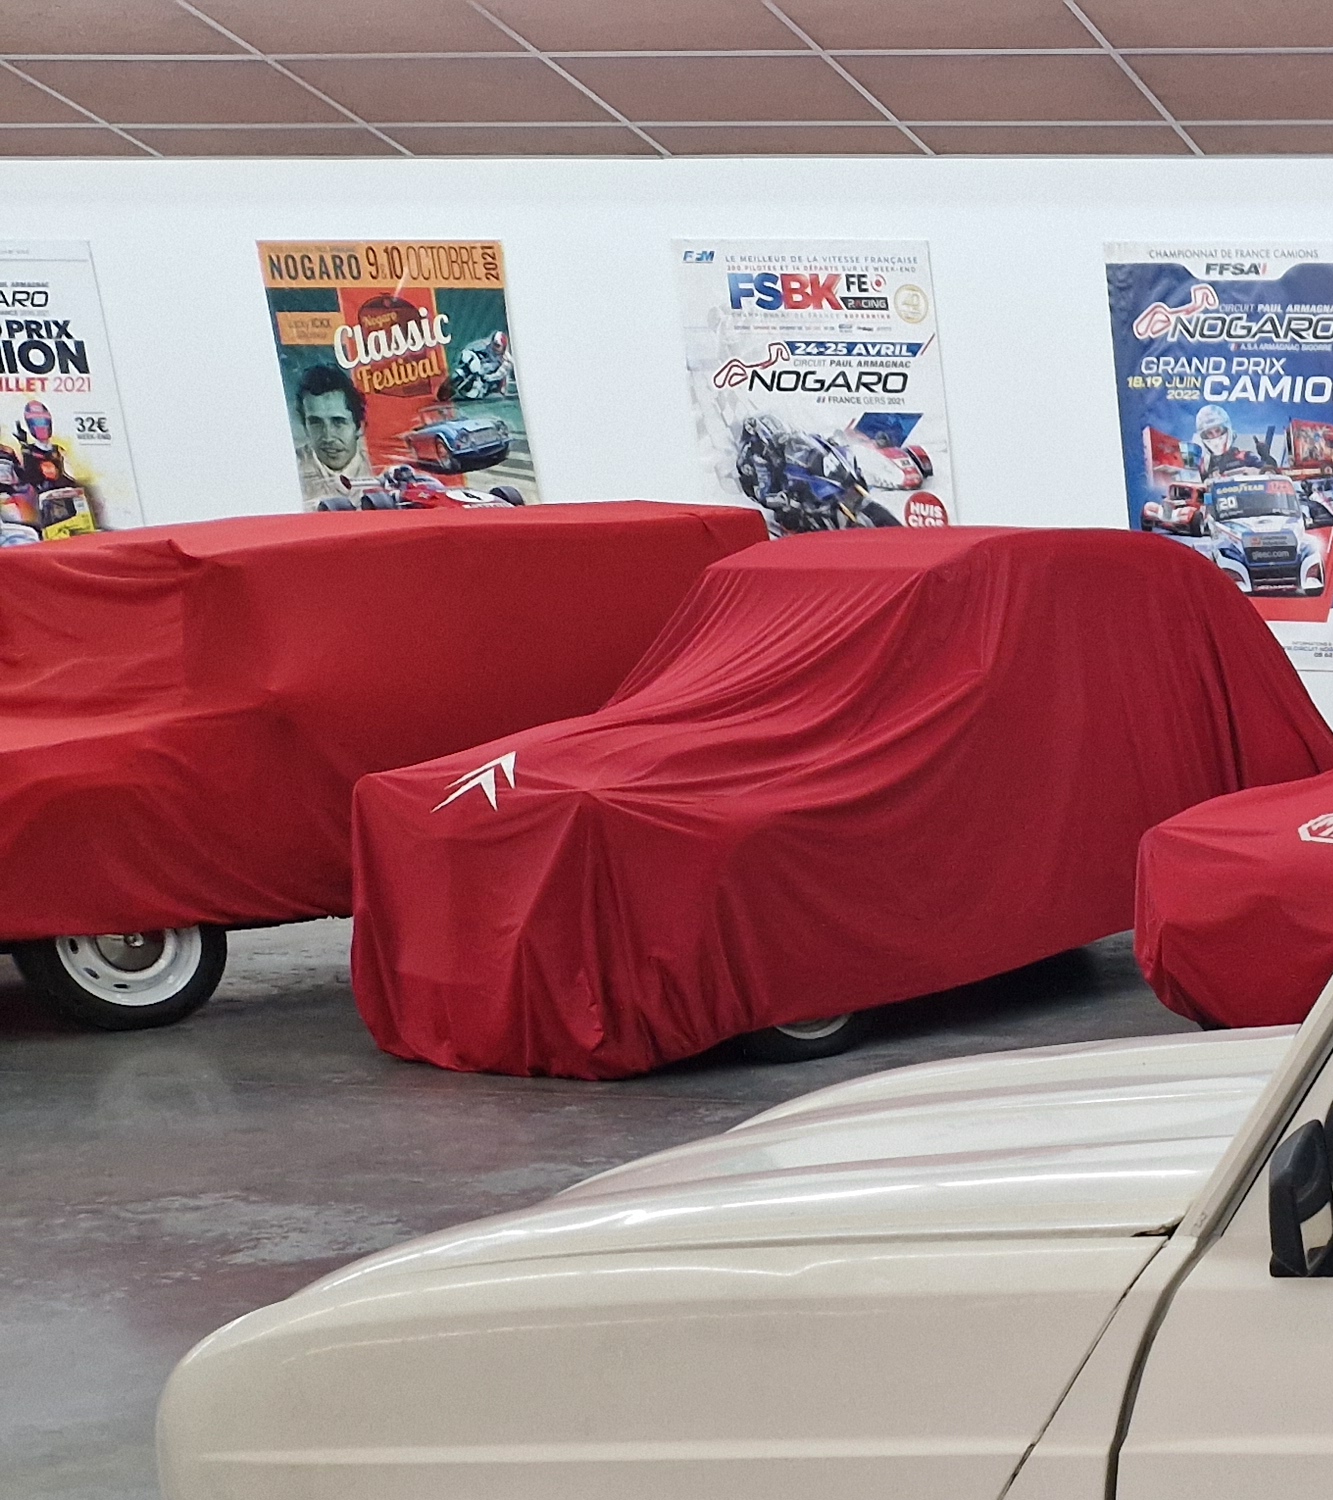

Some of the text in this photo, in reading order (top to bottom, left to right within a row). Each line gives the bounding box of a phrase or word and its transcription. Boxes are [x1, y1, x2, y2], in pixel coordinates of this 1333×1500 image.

[1149, 249, 1319, 259] CHAMPIONNAT DE FRANCE CAMIONS
[268, 254, 361, 281] NOGARO
[404, 245, 483, 281] OCTOBRE
[481, 245, 500, 281] 2021
[1205, 263, 1261, 276] FFSA
[727, 273, 844, 311] FSBK
[847, 299, 887, 309] RACING
[1219, 304, 1254, 313] CIRCUIT
[1257, 304, 1282, 313] PAUL
[362, 311, 397, 328] Nogaro
[5, 319, 74, 340] PRIX
[333, 306, 452, 369] Classic
[0, 340, 90, 374] ION
[795, 343, 913, 356] 24-25 AVRIL
[793, 359, 912, 368] CIRCUIT PAUL ARMAGNAC
[1141, 357, 1287, 376] GRAND PRIX
[356, 352, 442, 394] Festival
[53, 377, 91, 393] 2021
[748, 370, 909, 394] NOGARO
[1165, 376, 1201, 388] JUIN
[828, 396, 905, 405] FRANCE GERS 2021
[1167, 389, 1200, 401] 2022
[74, 417, 109, 433] 32€
[1216, 483, 1265, 495] GOODYEAR
[910, 501, 943, 518] HUIS
[1217, 496, 1237, 512] 20
